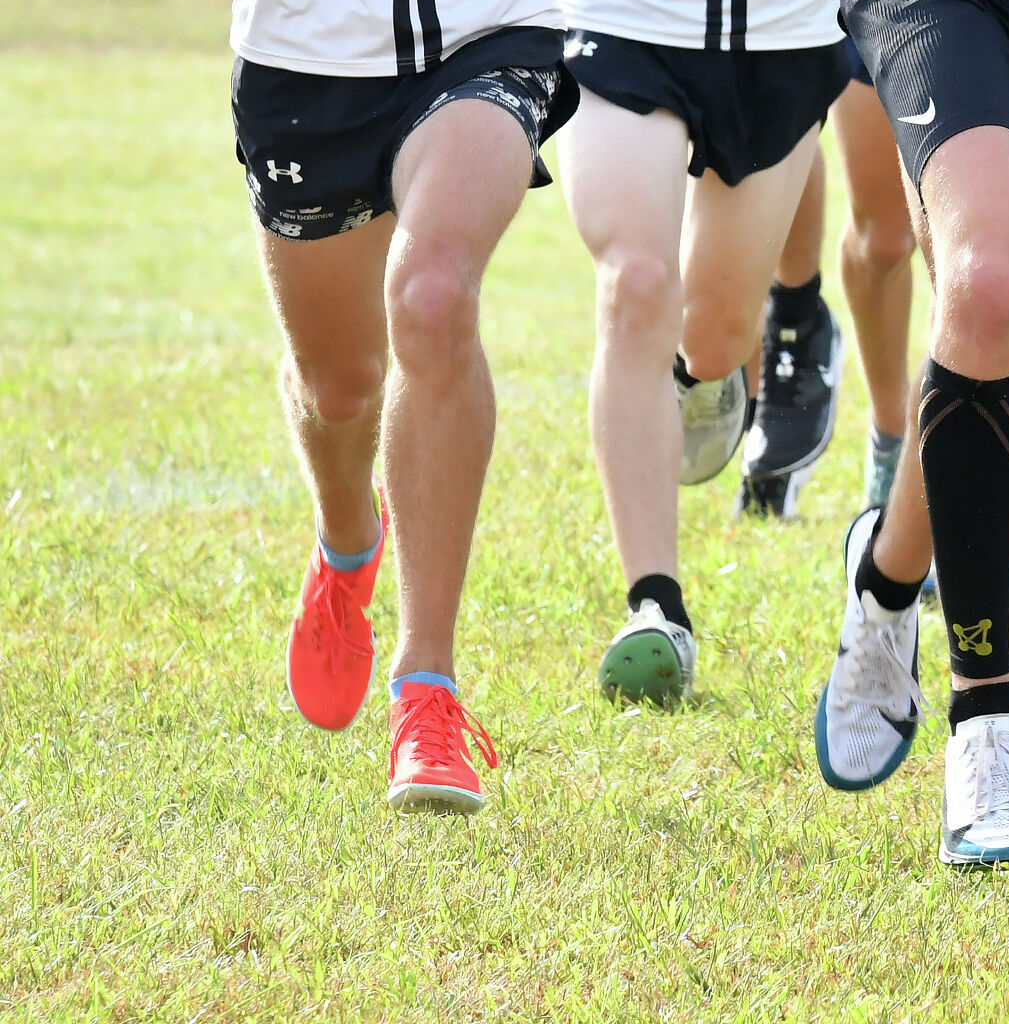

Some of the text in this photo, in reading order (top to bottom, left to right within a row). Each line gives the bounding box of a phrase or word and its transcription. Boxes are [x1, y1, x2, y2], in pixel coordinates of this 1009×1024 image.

[476, 92, 496, 101] new
[279, 211, 334, 221] new balance
